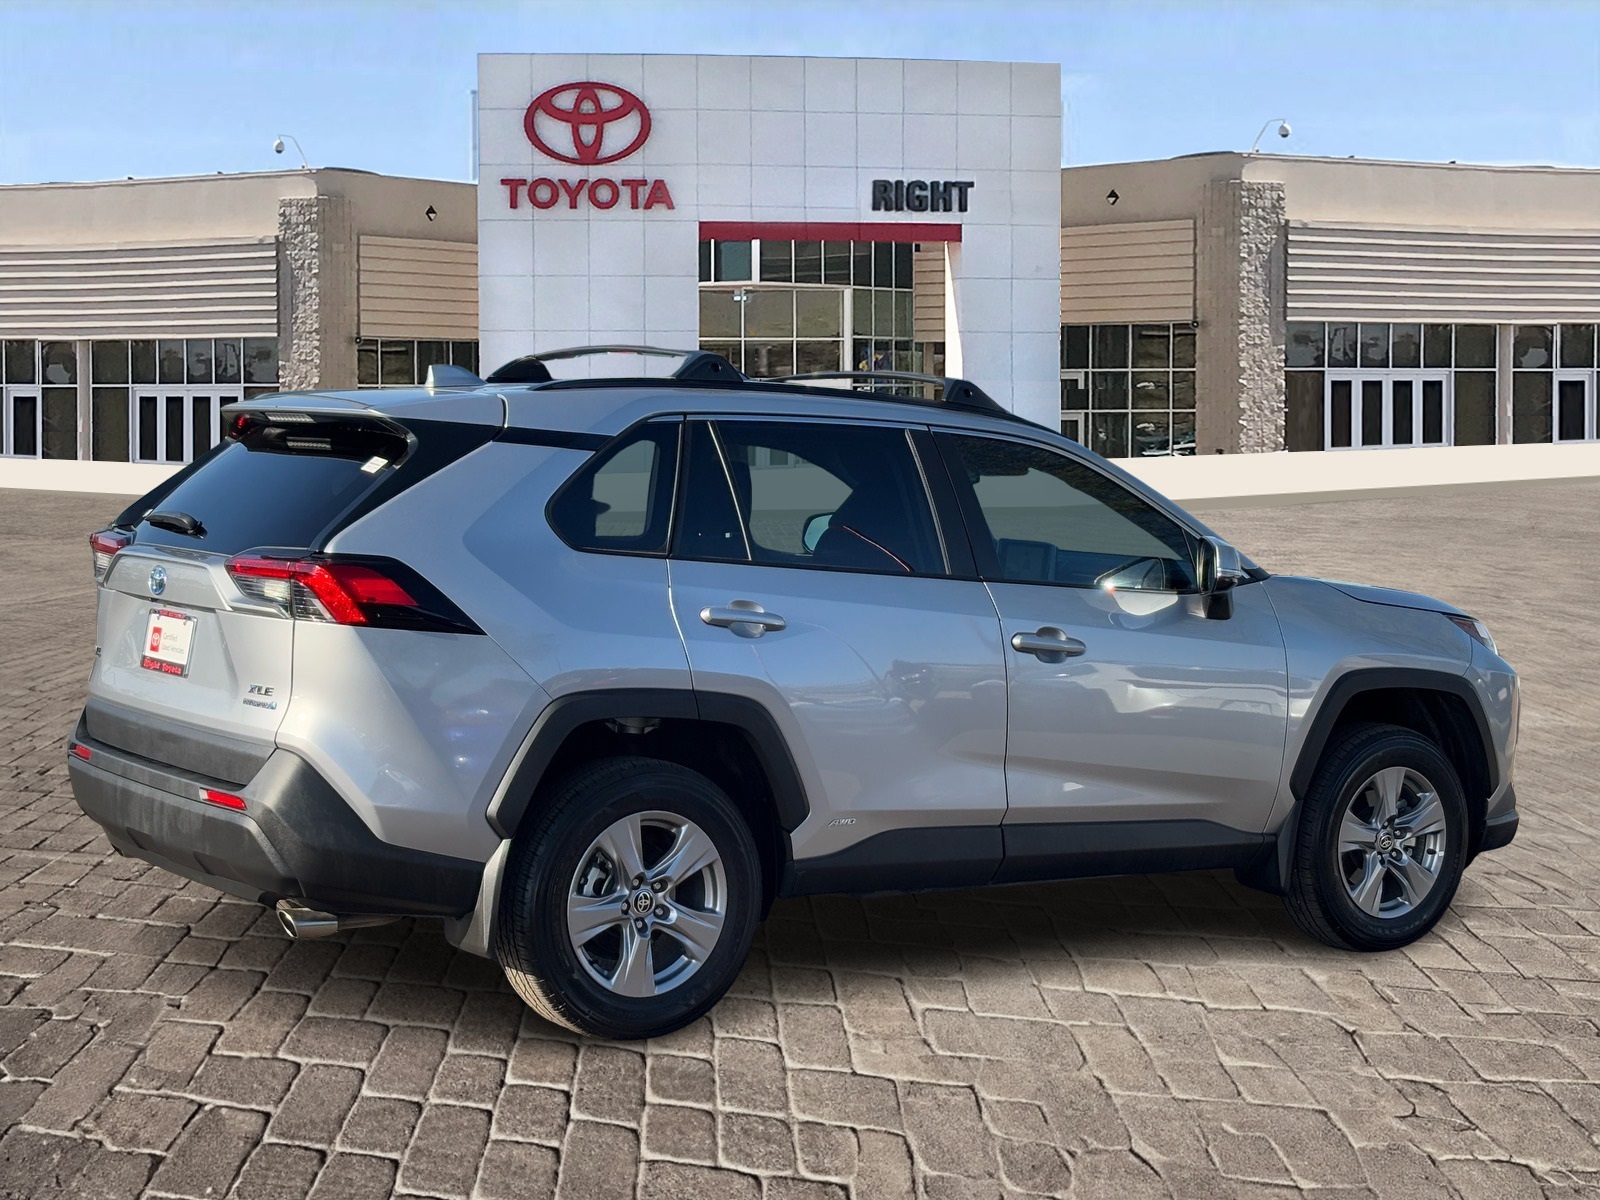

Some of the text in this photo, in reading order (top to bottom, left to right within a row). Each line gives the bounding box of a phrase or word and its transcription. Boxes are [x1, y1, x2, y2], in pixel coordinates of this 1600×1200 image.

[500, 178, 675, 210] TOYOTA
[872, 179, 975, 212] RIGHT
[143, 657, 182, 674] Right Toyota
[248, 684, 274, 697] XLE
[828, 817, 856, 827] AWD
